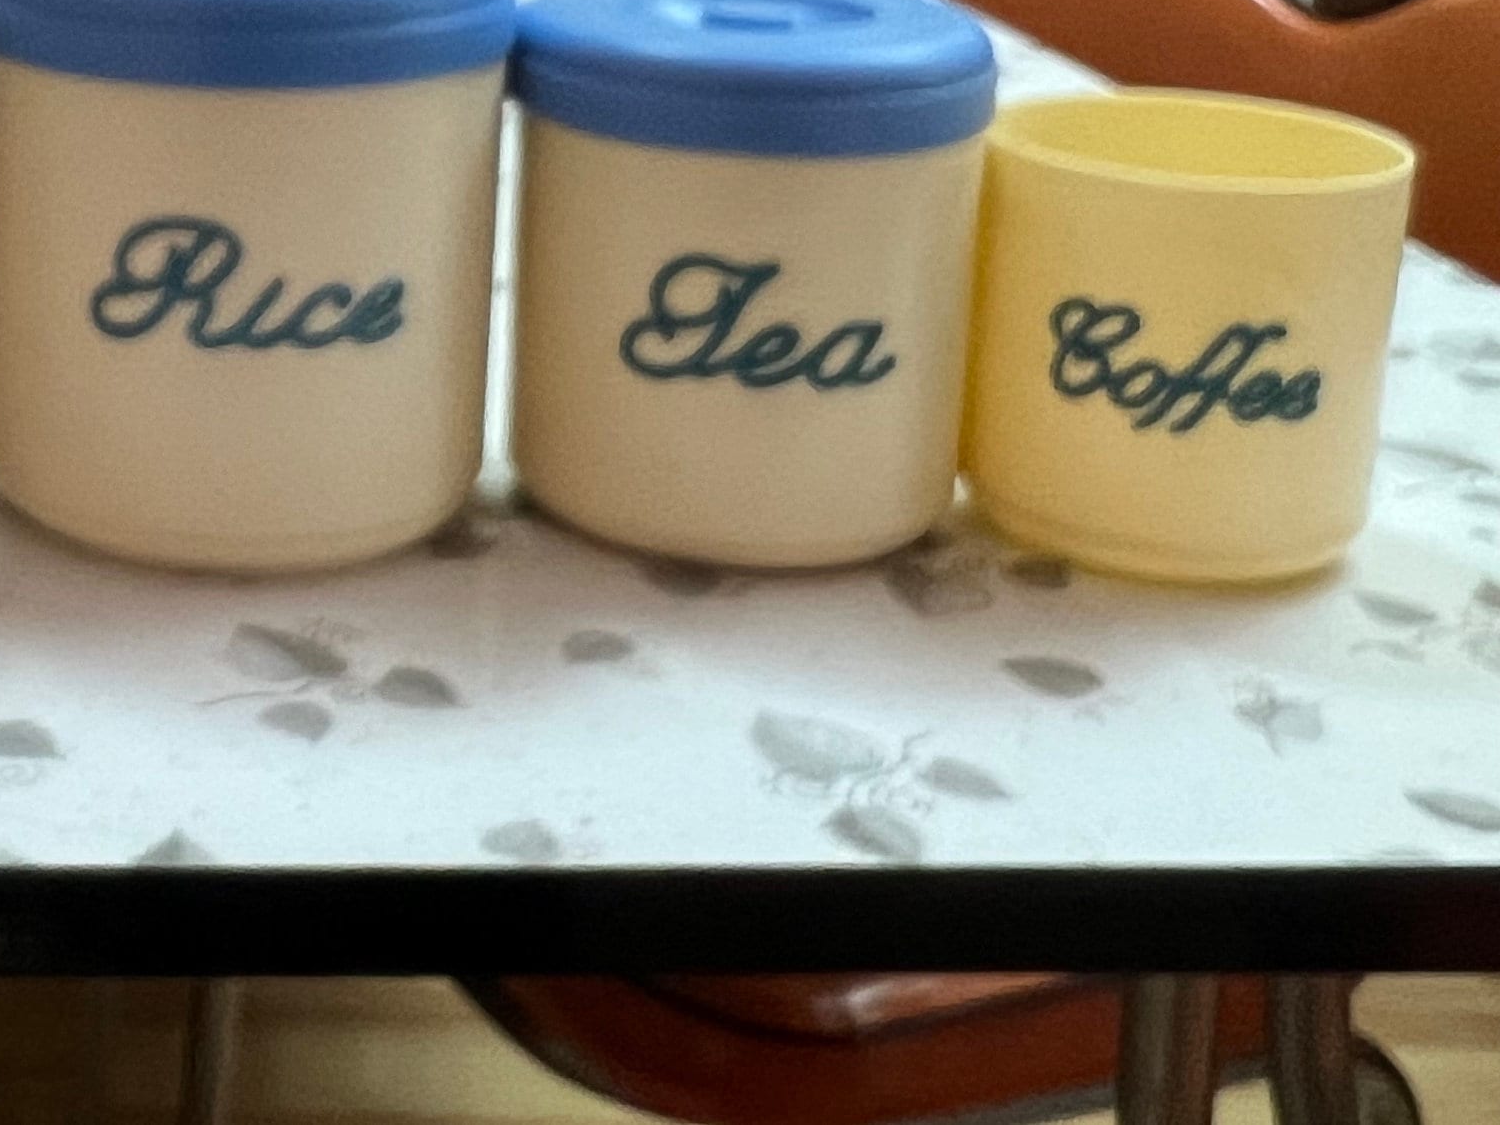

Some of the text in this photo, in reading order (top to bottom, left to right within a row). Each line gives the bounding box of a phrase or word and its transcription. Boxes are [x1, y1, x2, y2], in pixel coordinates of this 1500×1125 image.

[89, 215, 405, 350] Rice
[619, 253, 896, 391] Tea
[1049, 296, 1321, 433] Coffee
